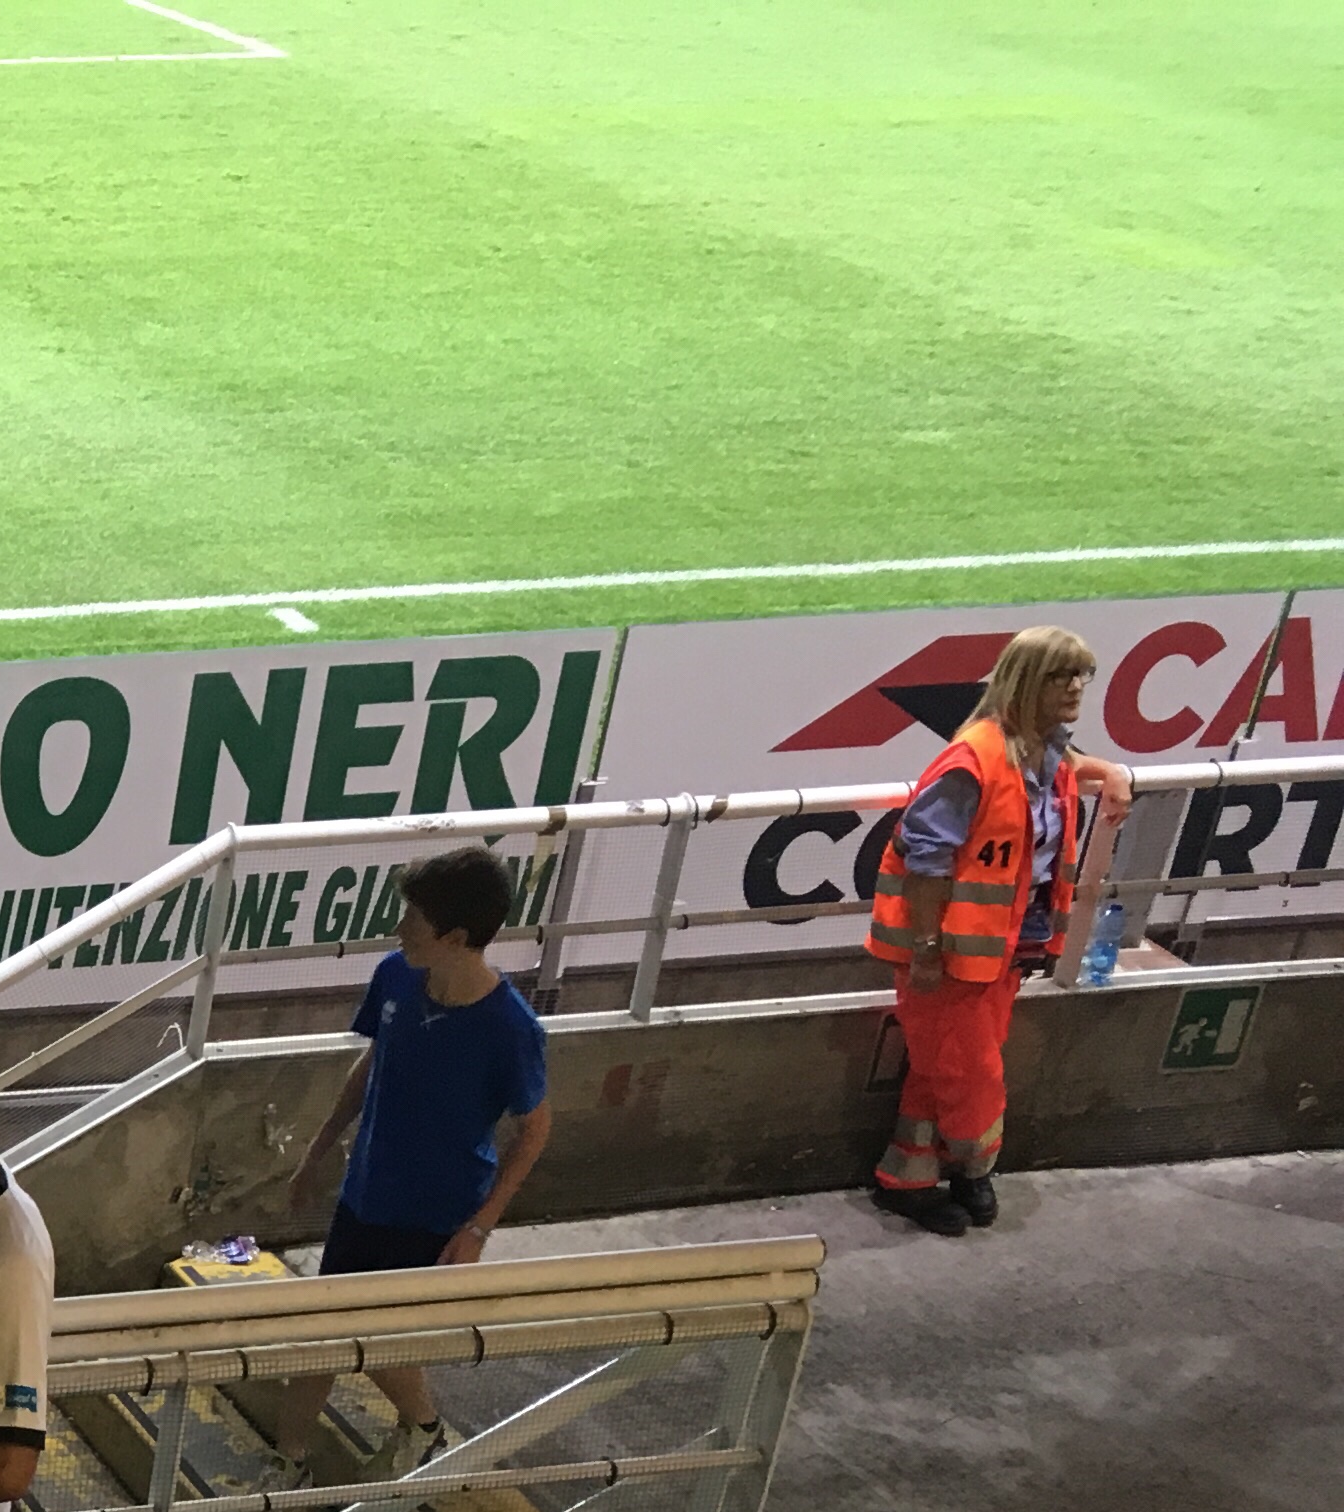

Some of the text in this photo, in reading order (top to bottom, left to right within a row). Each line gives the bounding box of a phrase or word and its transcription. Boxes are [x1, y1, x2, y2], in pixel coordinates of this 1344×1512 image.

[169, 650, 602, 847] NERI
[1103, 616, 1344, 754] CA
[977, 839, 1013, 868] 41
